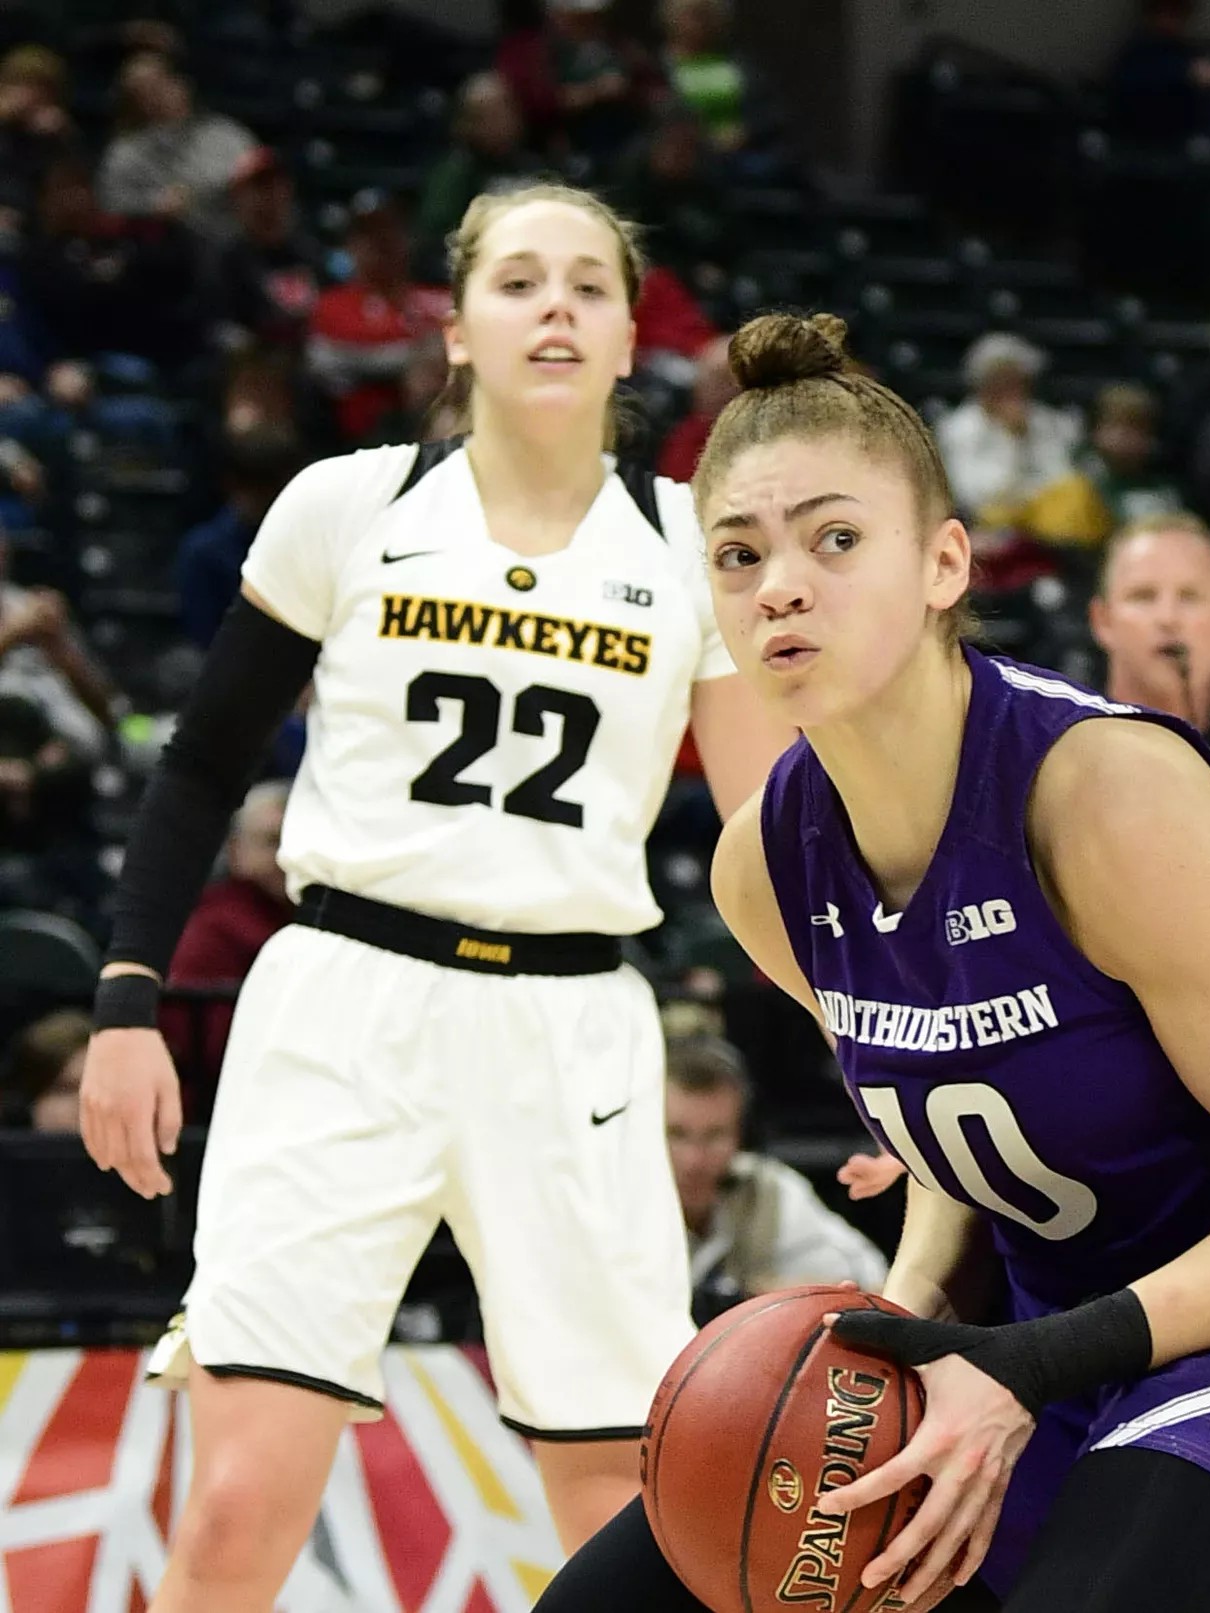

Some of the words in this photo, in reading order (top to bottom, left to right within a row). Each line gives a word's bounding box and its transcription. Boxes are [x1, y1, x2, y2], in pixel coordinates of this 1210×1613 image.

[379, 594, 652, 677] HAWKEYES
[406, 671, 601, 829] 22
[860, 1083, 1098, 1241] 10
